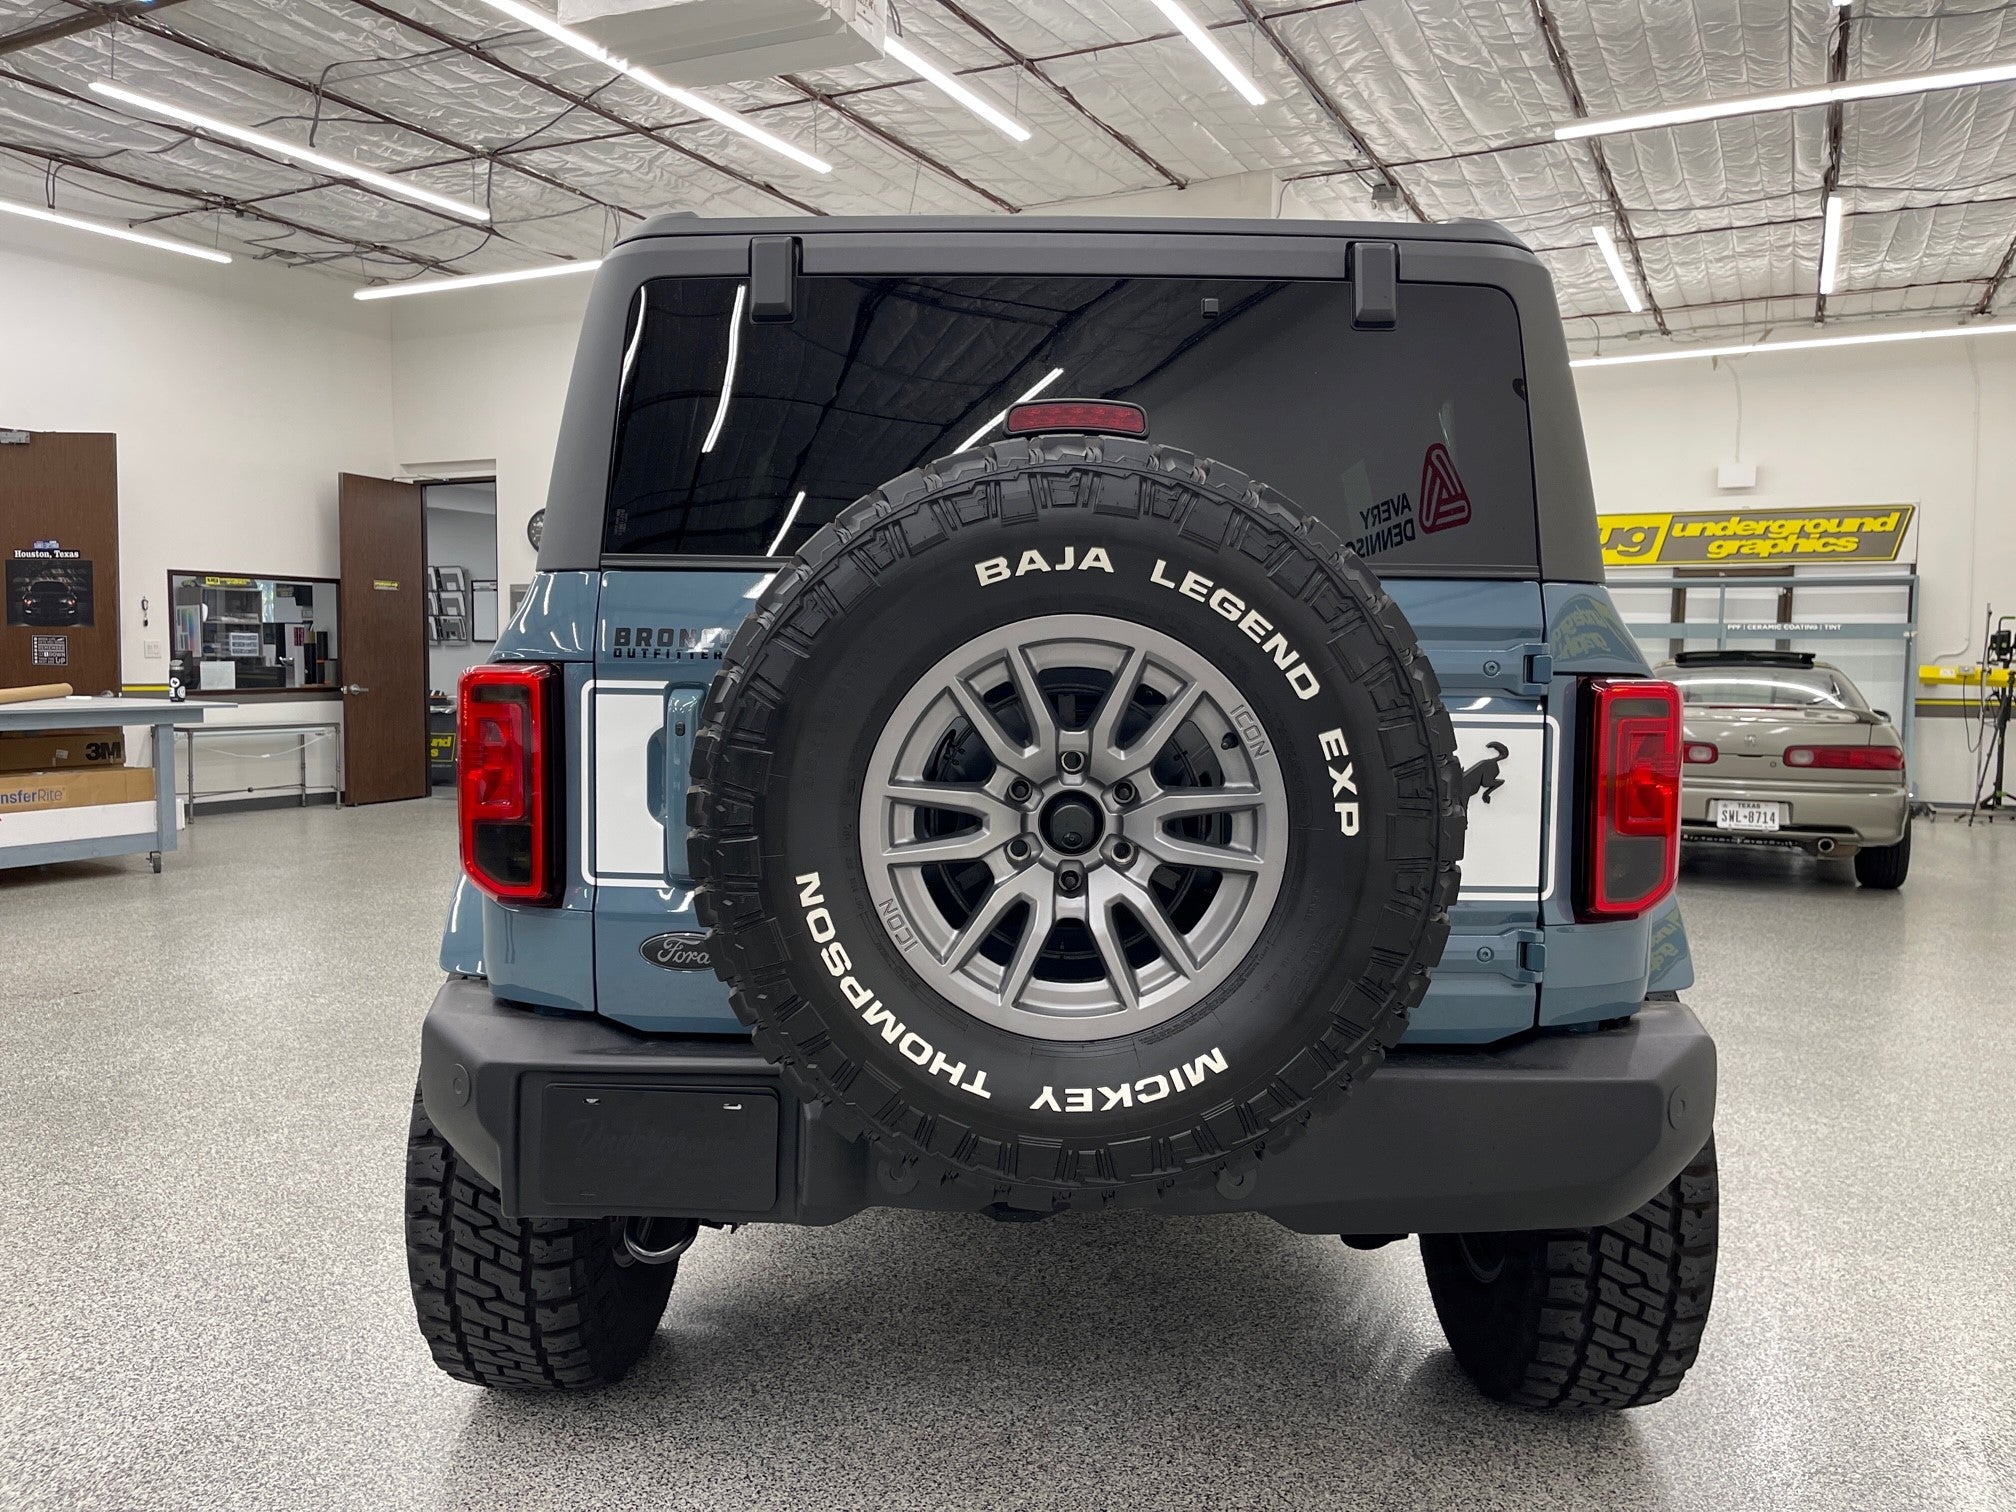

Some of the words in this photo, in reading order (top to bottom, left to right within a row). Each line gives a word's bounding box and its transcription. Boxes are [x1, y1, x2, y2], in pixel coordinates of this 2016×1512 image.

[1671, 511, 1901, 539] underground
[14, 549, 53, 559] Houston,
[54, 549, 79, 558] Texas
[1707, 533, 1860, 559] graphics
[1747, 623, 1782, 631] CERAMIC
[1783, 623, 1818, 631] COATING
[1824, 623, 1842, 631] TINT
[974, 546, 1115, 587] BAJA
[1150, 559, 1321, 701] LEGEND
[1318, 728, 1360, 837] EXP
[85, 742, 121, 761] 3M
[1229, 704, 1270, 759] ICON
[877, 898, 919, 953] ICON
[795, 871, 992, 1100] THOMPSON
[1029, 1047, 1230, 1113] MICKEY
